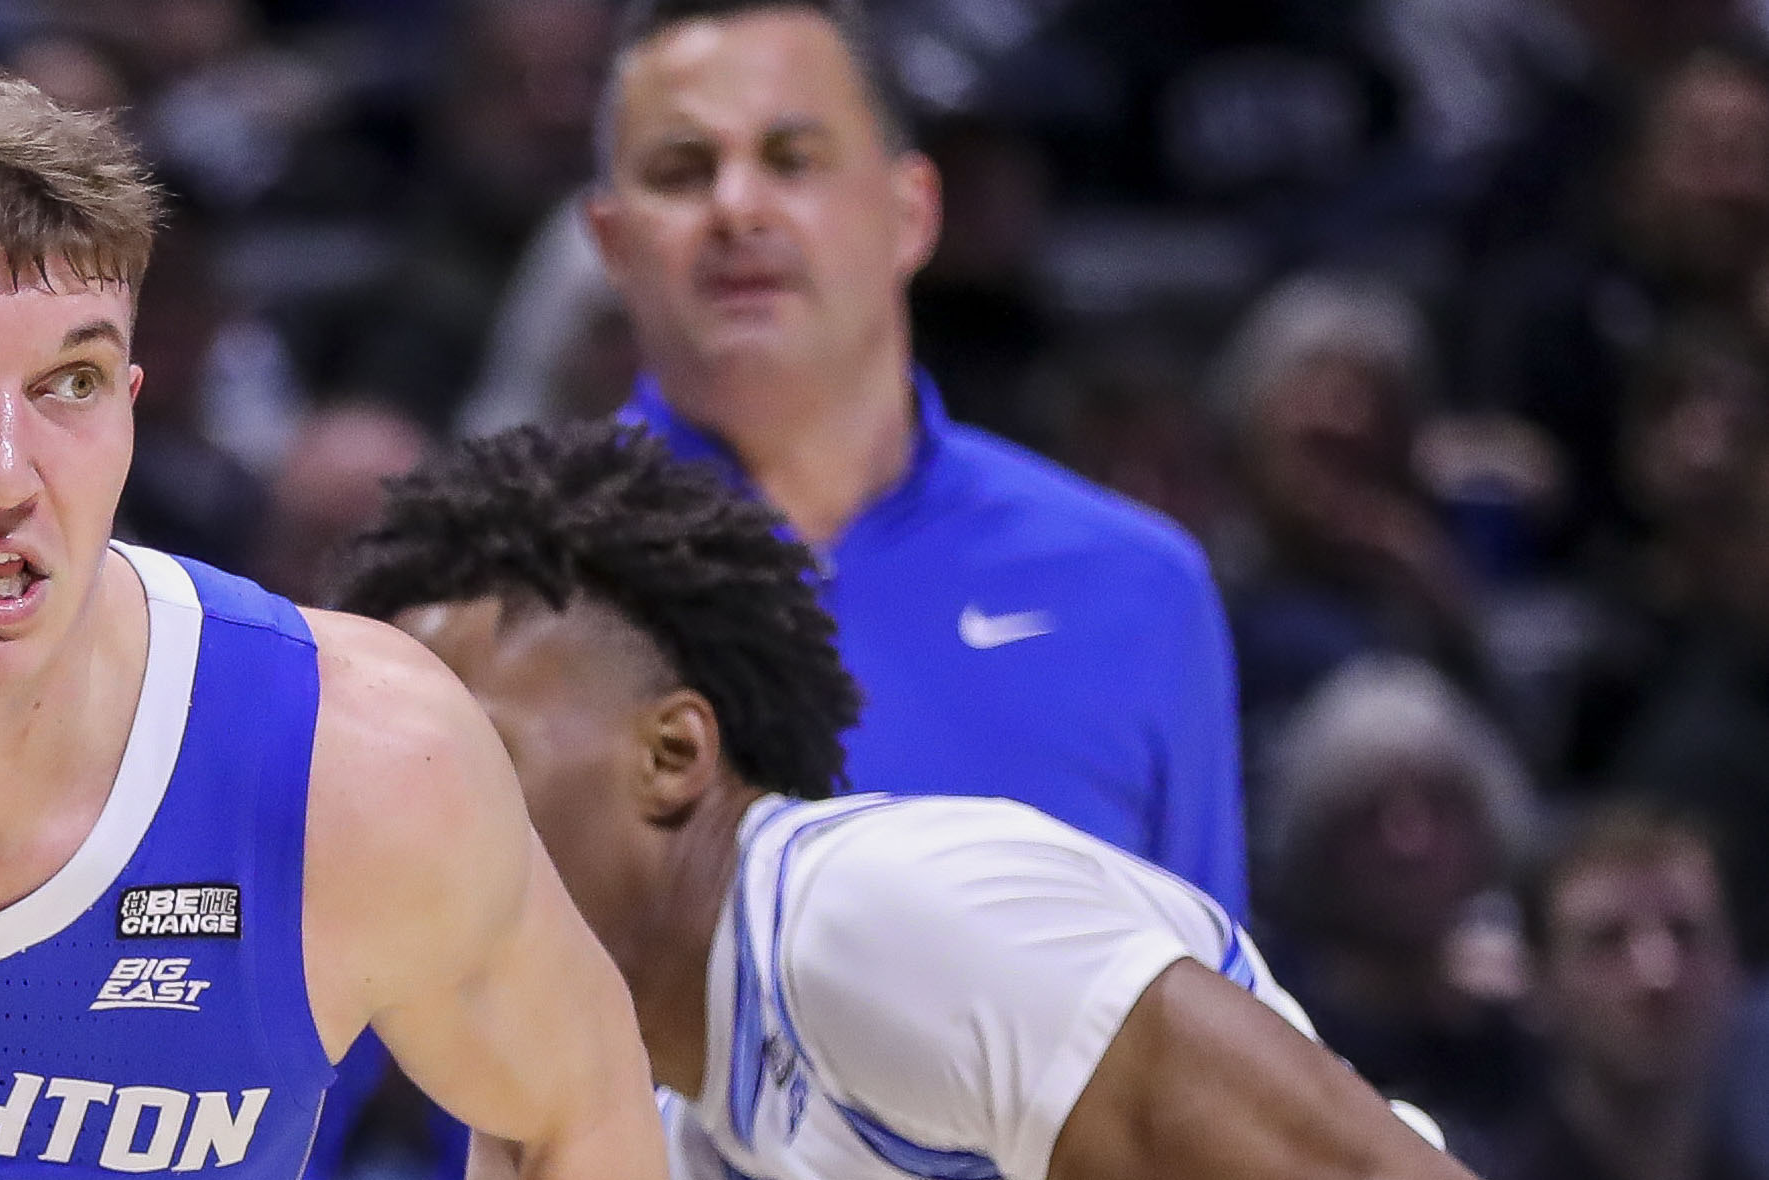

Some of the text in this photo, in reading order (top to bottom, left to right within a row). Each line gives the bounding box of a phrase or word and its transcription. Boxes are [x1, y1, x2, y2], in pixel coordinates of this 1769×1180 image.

[121, 914, 237, 934] CHANGE
[109, 958, 191, 981] BIG
[96, 980, 211, 1002] EAST
